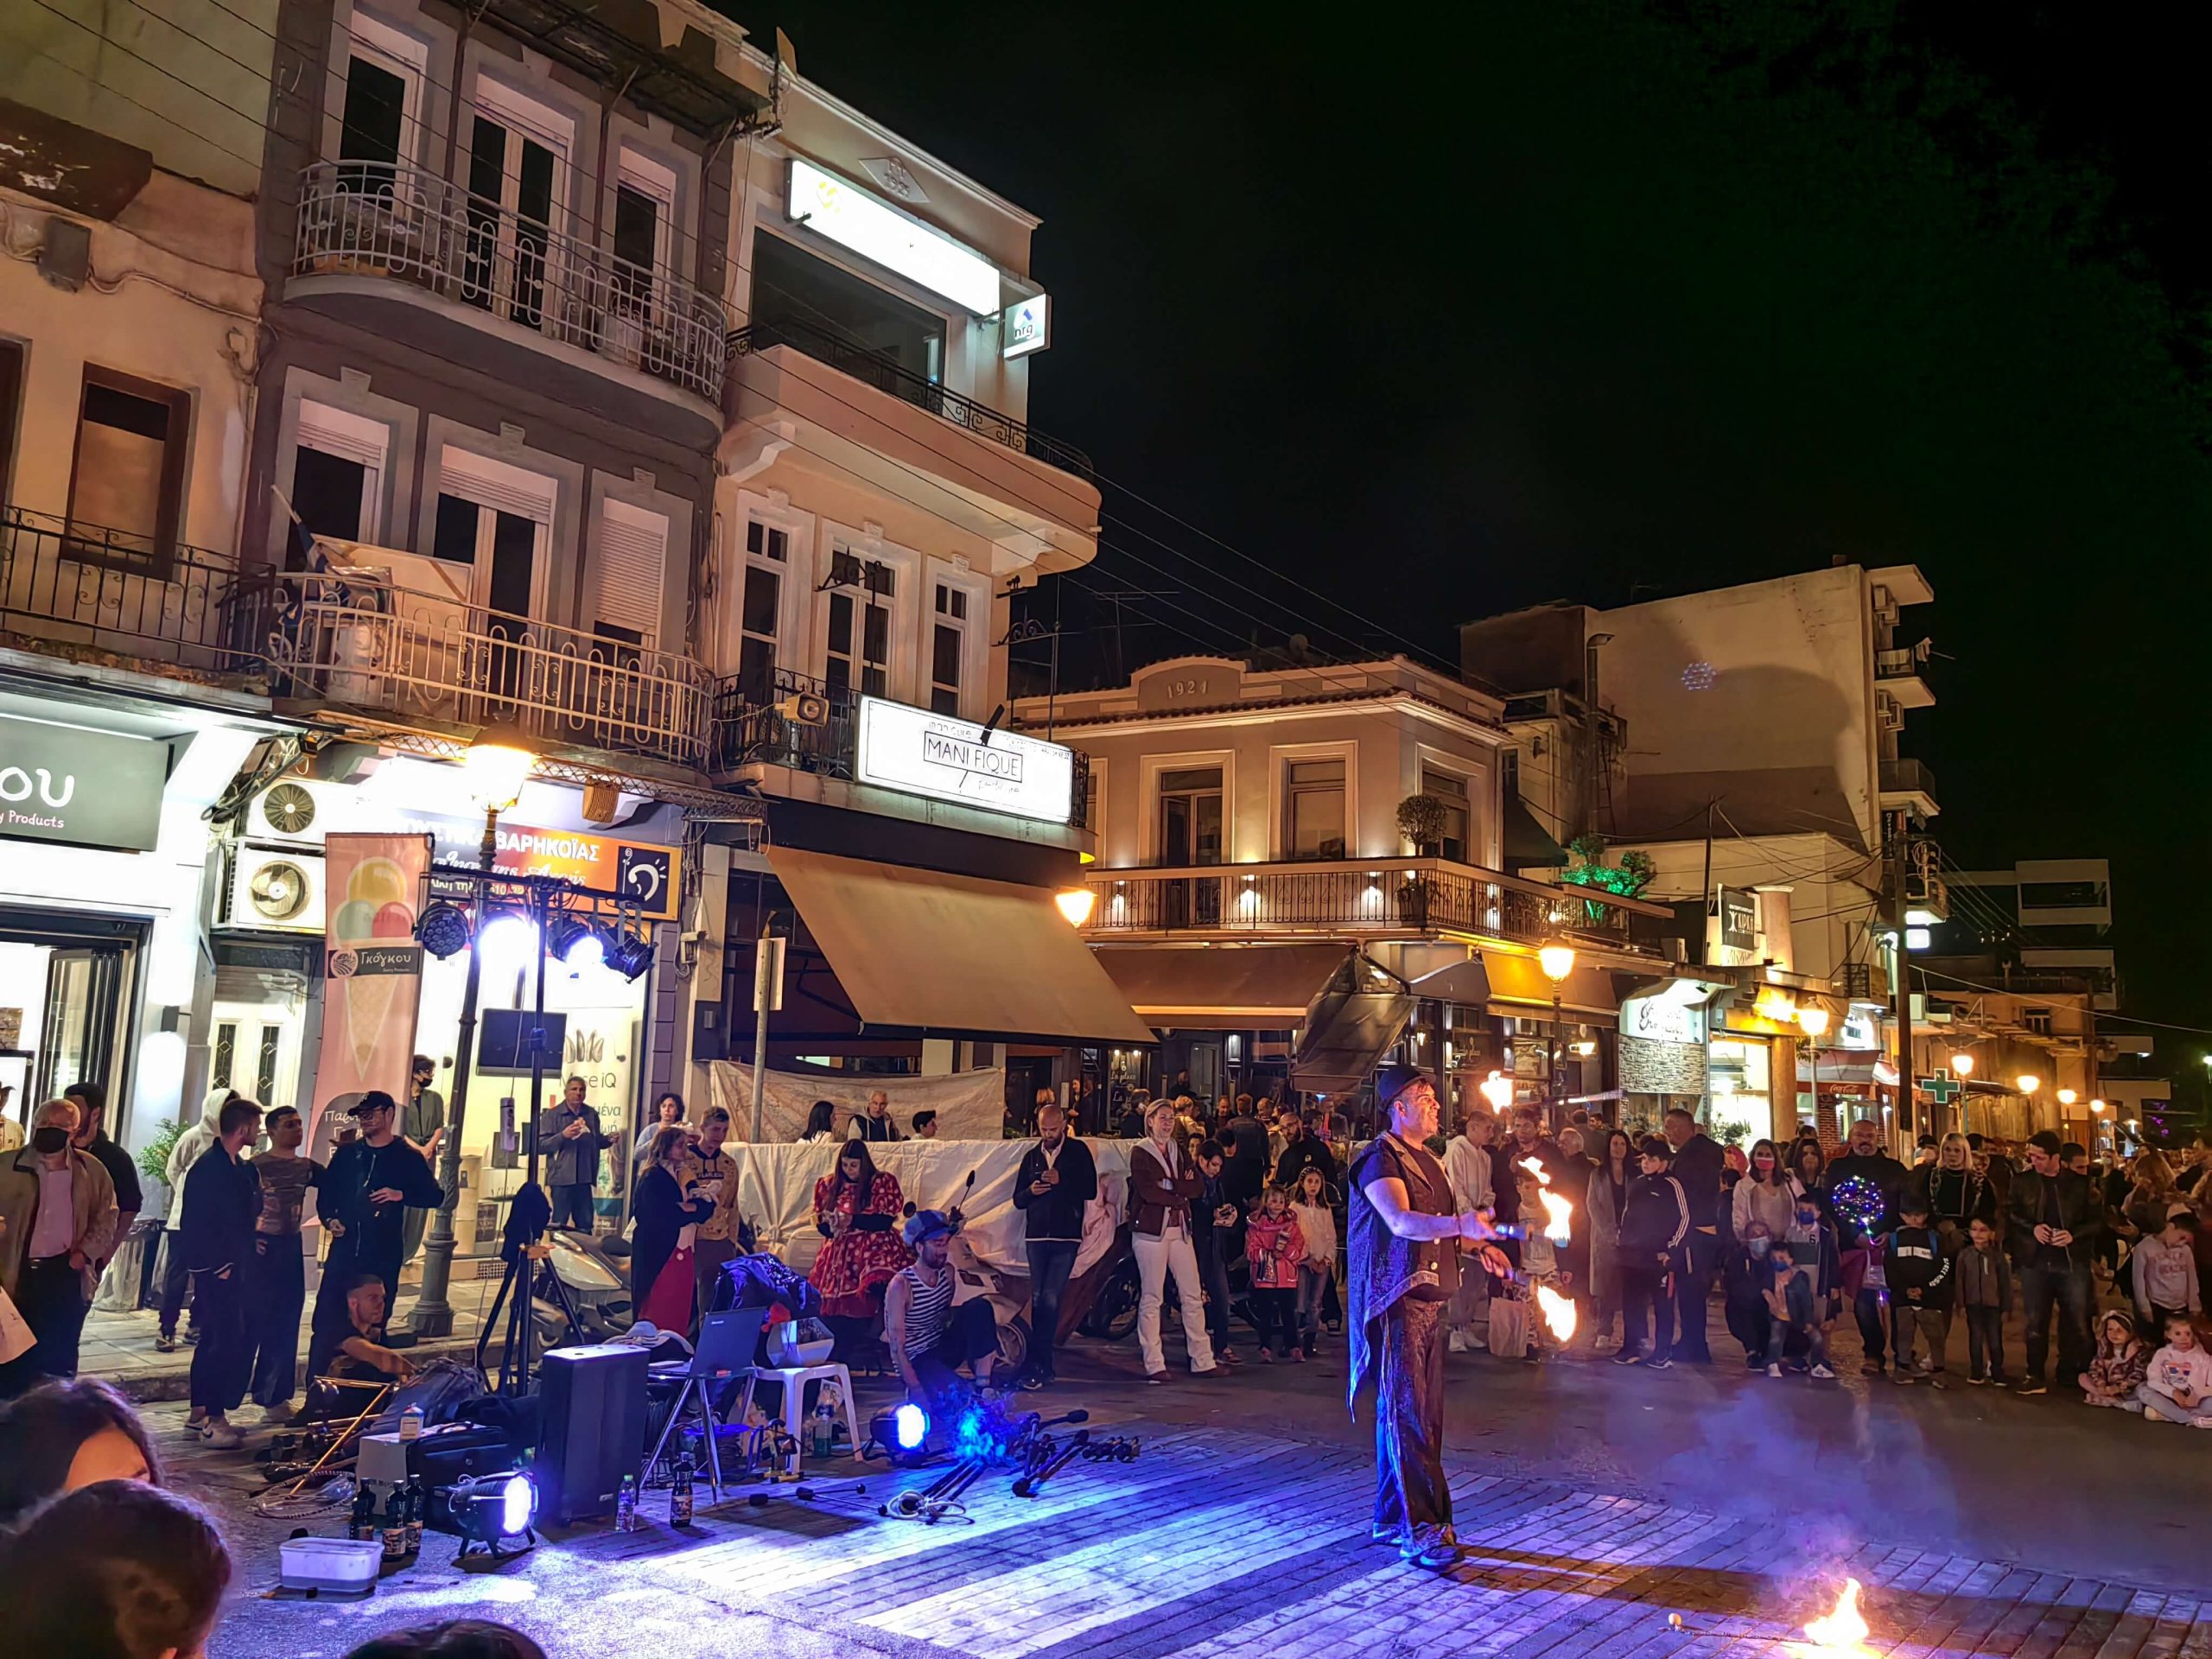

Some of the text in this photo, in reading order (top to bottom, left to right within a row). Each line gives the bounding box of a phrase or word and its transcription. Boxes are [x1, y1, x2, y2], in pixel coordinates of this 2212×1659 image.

[1014, 324, 1033, 338] nrg
[975, 749, 1020, 776] FIQUE
[9, 810, 65, 829] Products
[495, 830, 600, 862] ΒΑΡΗΚΟΪΑΣ
[360, 951, 411, 967] Γκόγκου
[601, 1072, 617, 1089] iQ
